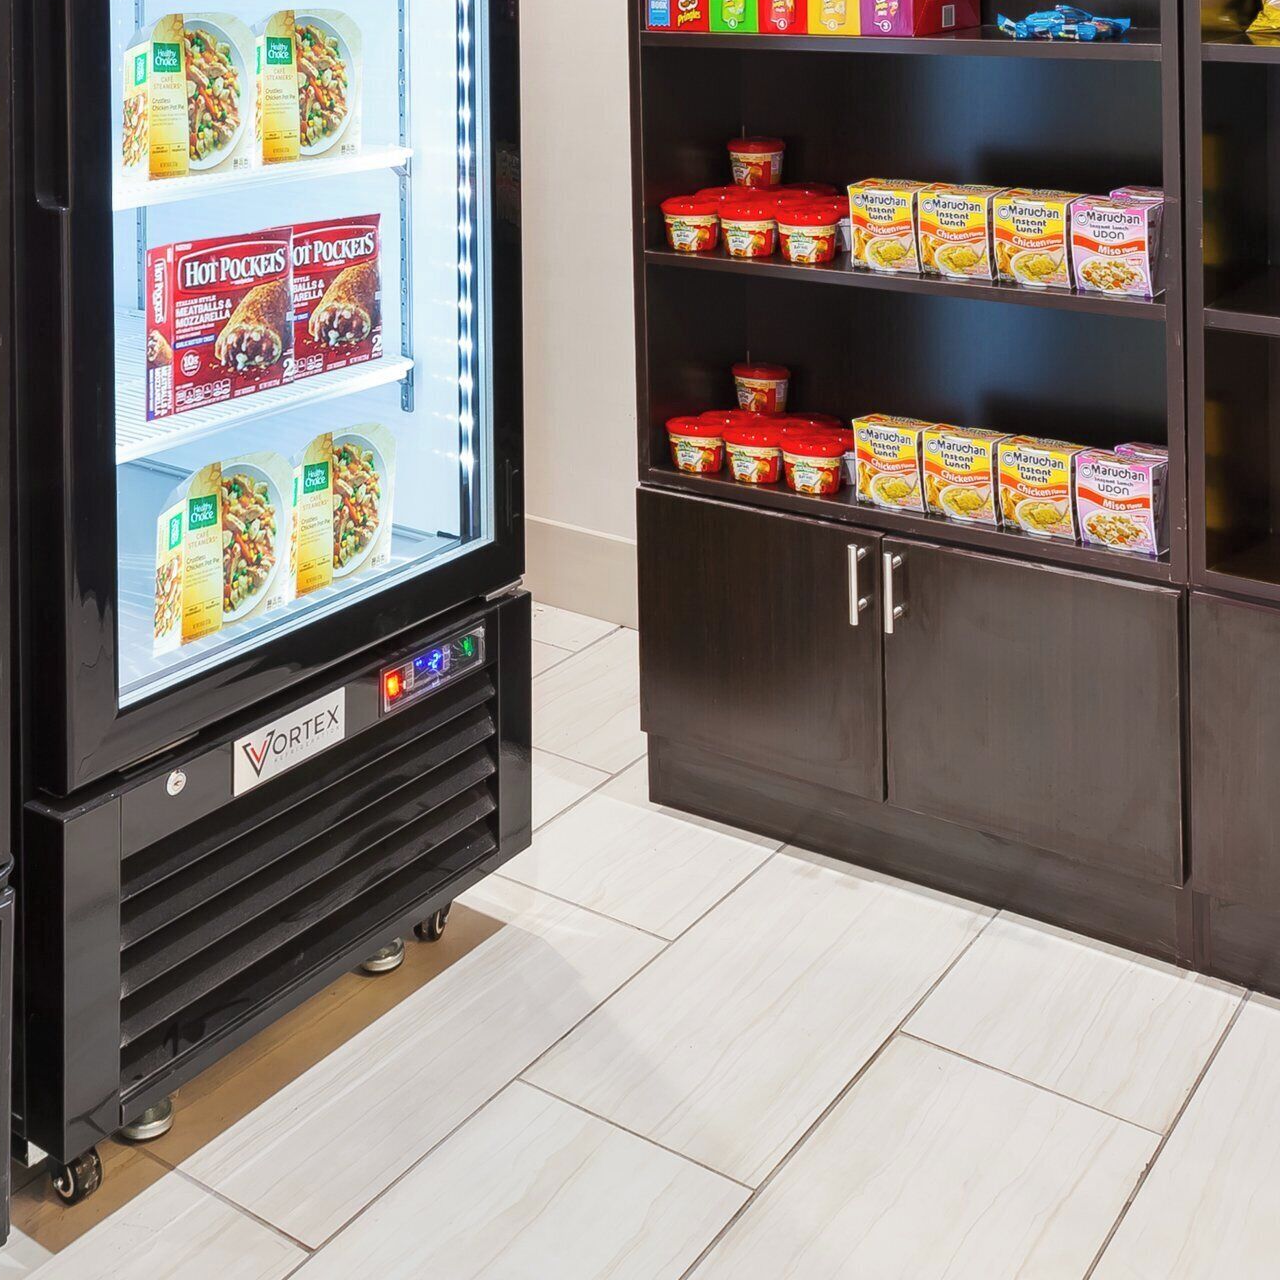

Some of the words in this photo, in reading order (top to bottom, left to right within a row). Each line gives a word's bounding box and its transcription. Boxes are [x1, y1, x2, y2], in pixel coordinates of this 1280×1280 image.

[678, 9, 701, 27] Pringles
[158, 48, 176, 58] Healthy
[155, 56, 178, 66] Choice
[862, 193, 906, 207] Maruchan
[865, 206, 895, 215] Instant
[869, 212, 893, 221] Lunch
[1008, 204, 1059, 219] Maruchan
[1086, 211, 1140, 225] Maruchan
[866, 223, 895, 235] Chicken
[1093, 231, 1124, 240] UDON
[1097, 243, 1121, 255] Miso
[185, 260, 219, 288] HOT
[220, 248, 285, 281] POCKETS
[306, 469, 325, 480] Healthy
[305, 475, 326, 488] Choice
[193, 503, 213, 514] Healthy
[190, 510, 214, 523] Choice
[242, 704, 339, 778] VORTEX
